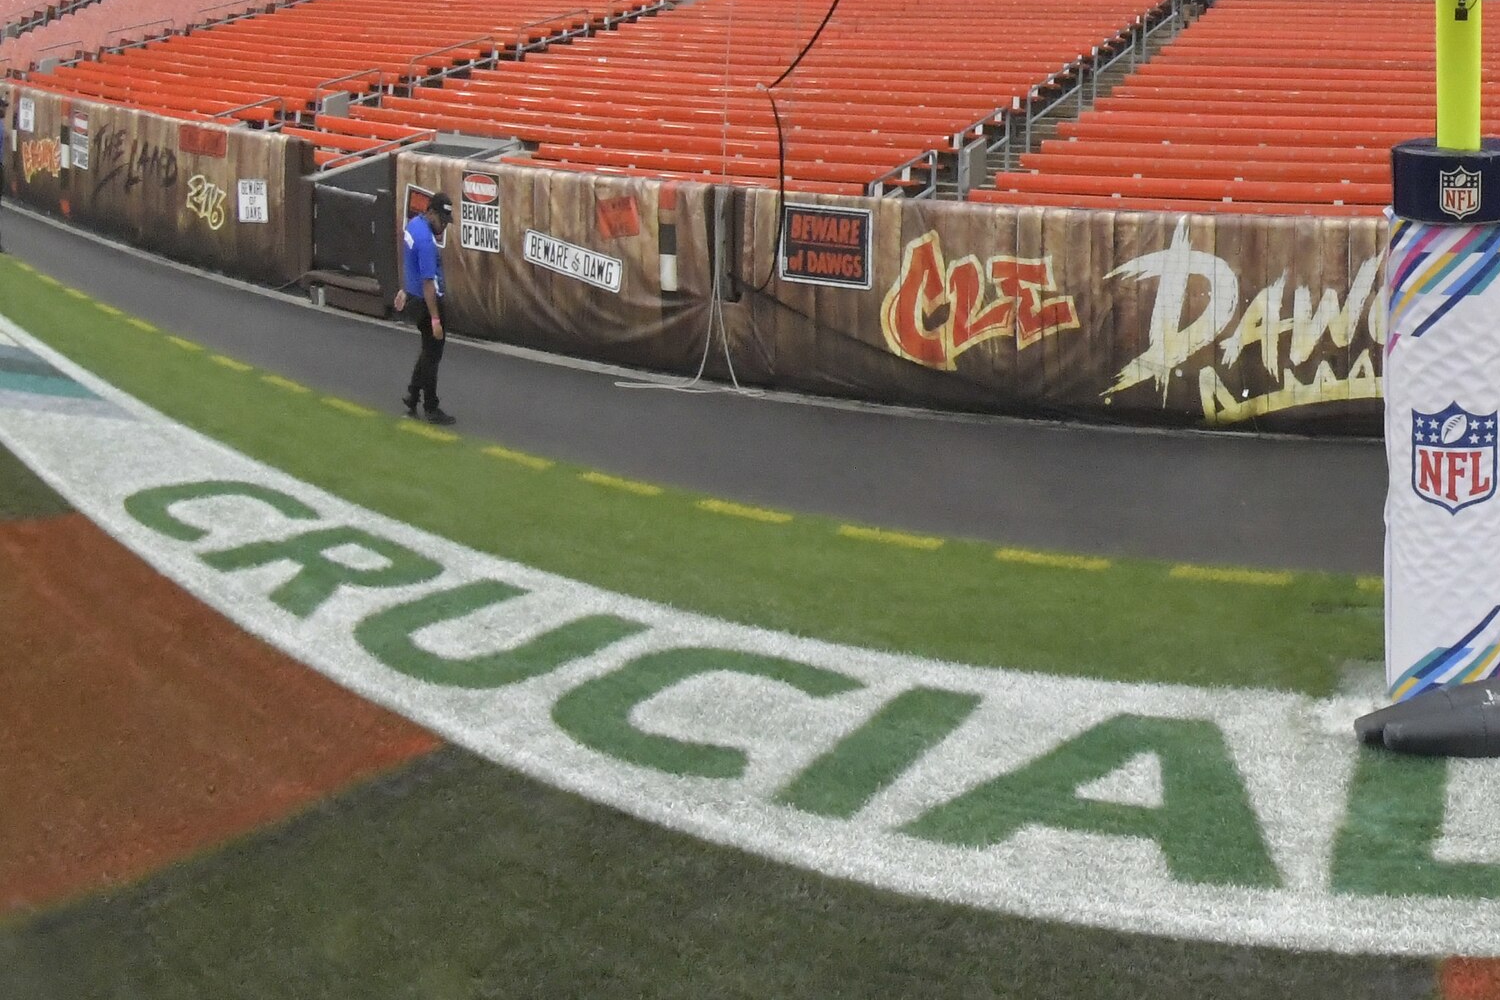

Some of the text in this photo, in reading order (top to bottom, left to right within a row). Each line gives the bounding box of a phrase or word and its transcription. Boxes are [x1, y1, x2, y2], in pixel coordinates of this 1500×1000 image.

[462, 202, 499, 225] BEWARE
[1444, 189, 1476, 210] NFL
[462, 225, 499, 249] OF DAWG
[791, 213, 861, 245] BEWARE
[530, 236, 569, 269] BEWARE
[583, 254, 614, 284] DAWG
[807, 250, 863, 278] DAWGS
[881, 229, 1080, 372] CLE
[1100, 215, 1386, 410] DAW
[1418, 450, 1491, 501] NFL
